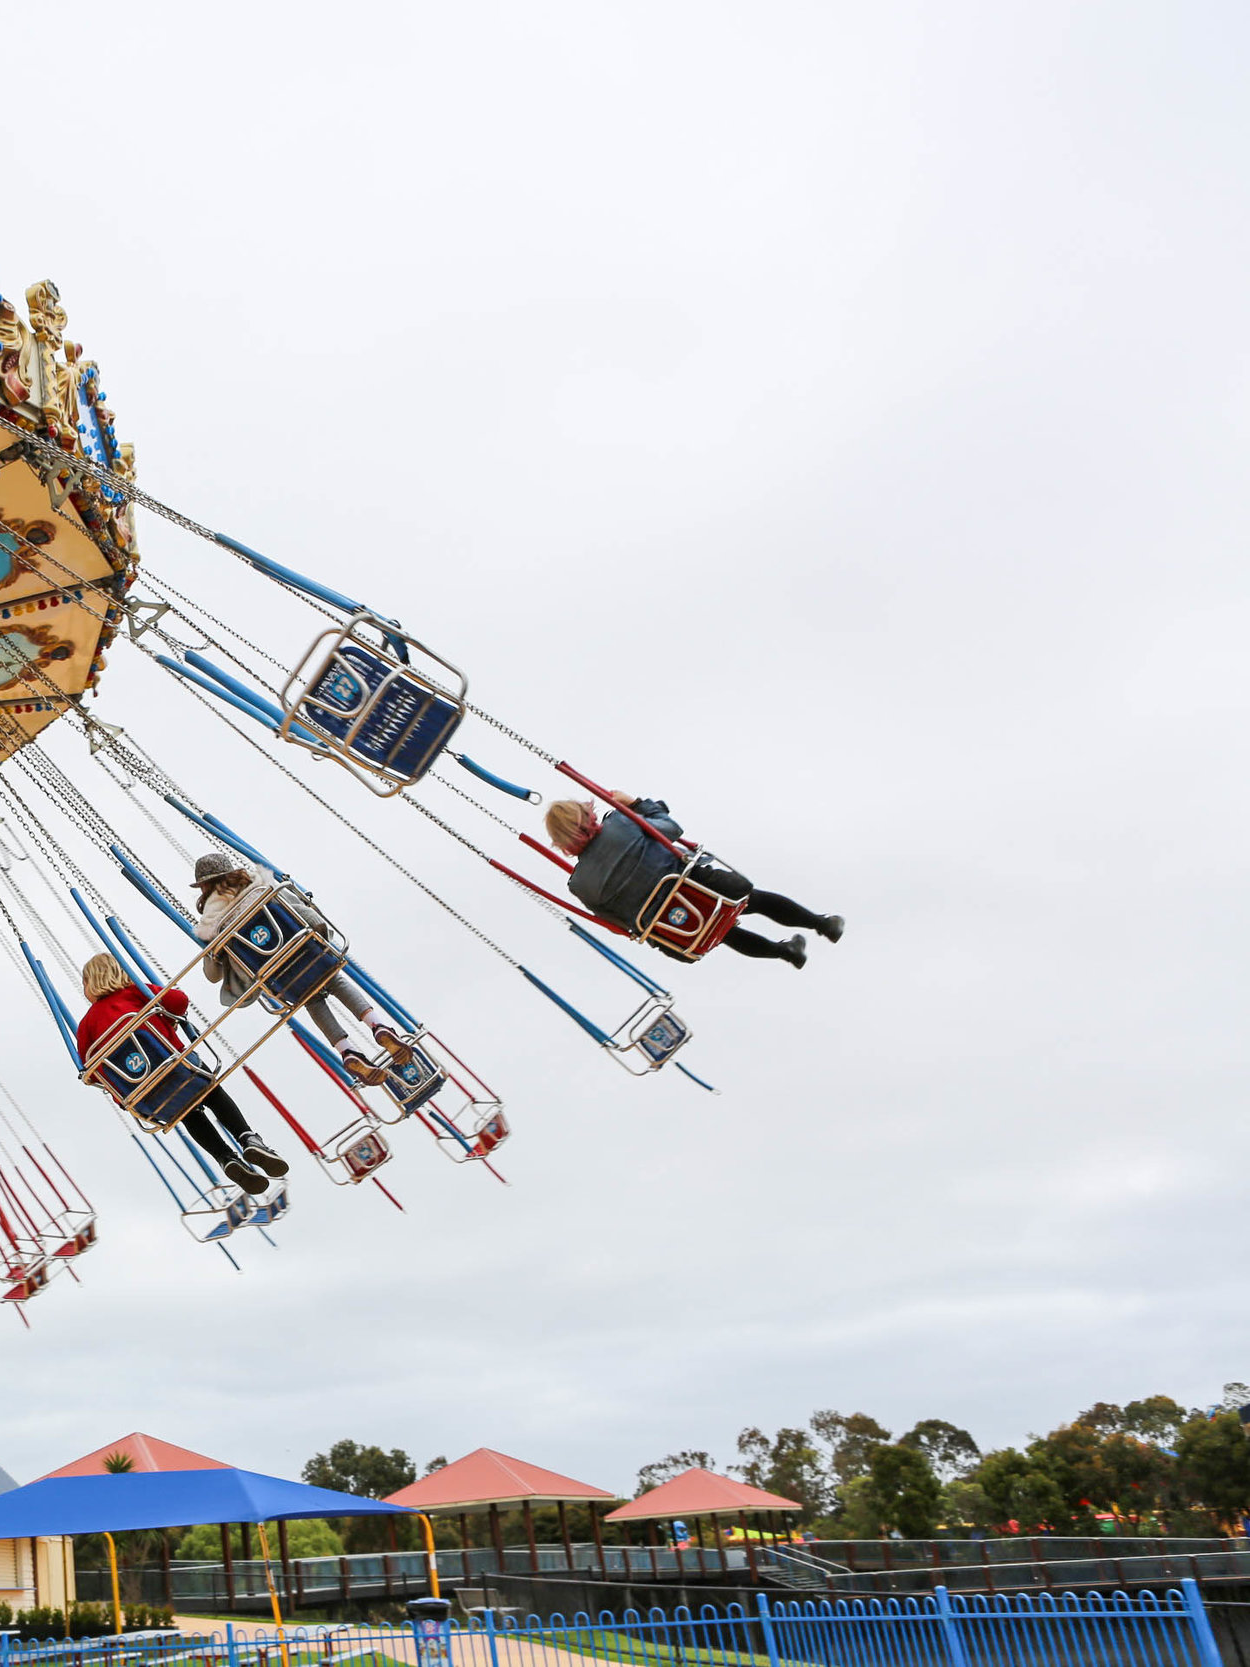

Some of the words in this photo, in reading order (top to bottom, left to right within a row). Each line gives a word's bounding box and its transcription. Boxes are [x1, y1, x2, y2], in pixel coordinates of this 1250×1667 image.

[335, 676, 355, 699] 27
[670, 909, 686, 924] 23
[253, 928, 269, 944] 25
[129, 1055, 144, 1070] 22
